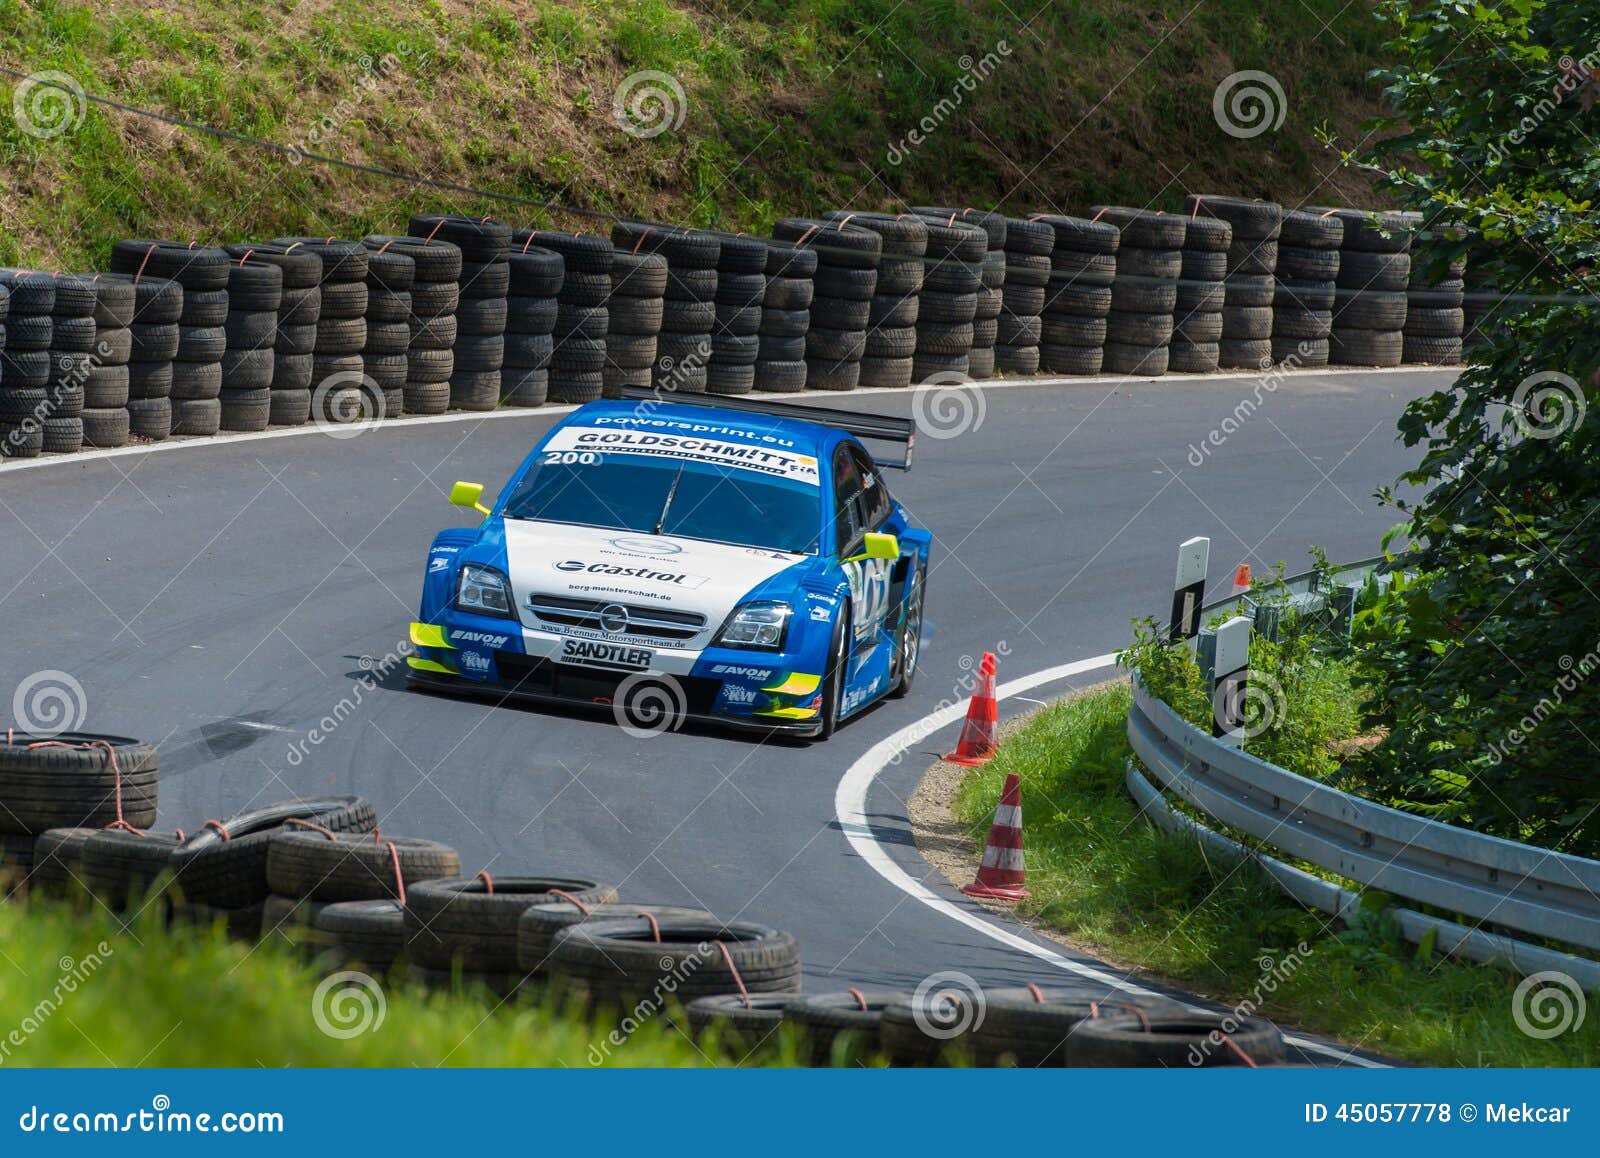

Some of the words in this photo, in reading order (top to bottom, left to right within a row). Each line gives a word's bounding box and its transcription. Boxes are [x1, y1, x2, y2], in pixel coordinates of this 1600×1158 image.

[594, 417, 794, 447] powersprint.eu
[543, 451, 596, 465] 200
[587, 563, 688, 585] Castrol
[568, 584, 672, 601] berg-meisterschaft.de
[461, 631, 508, 644] AVON
[541, 624, 686, 649] www.Brenner-Motorsportteam.de
[562, 639, 653, 666] SANDTLER
[725, 667, 772, 678] AVON
